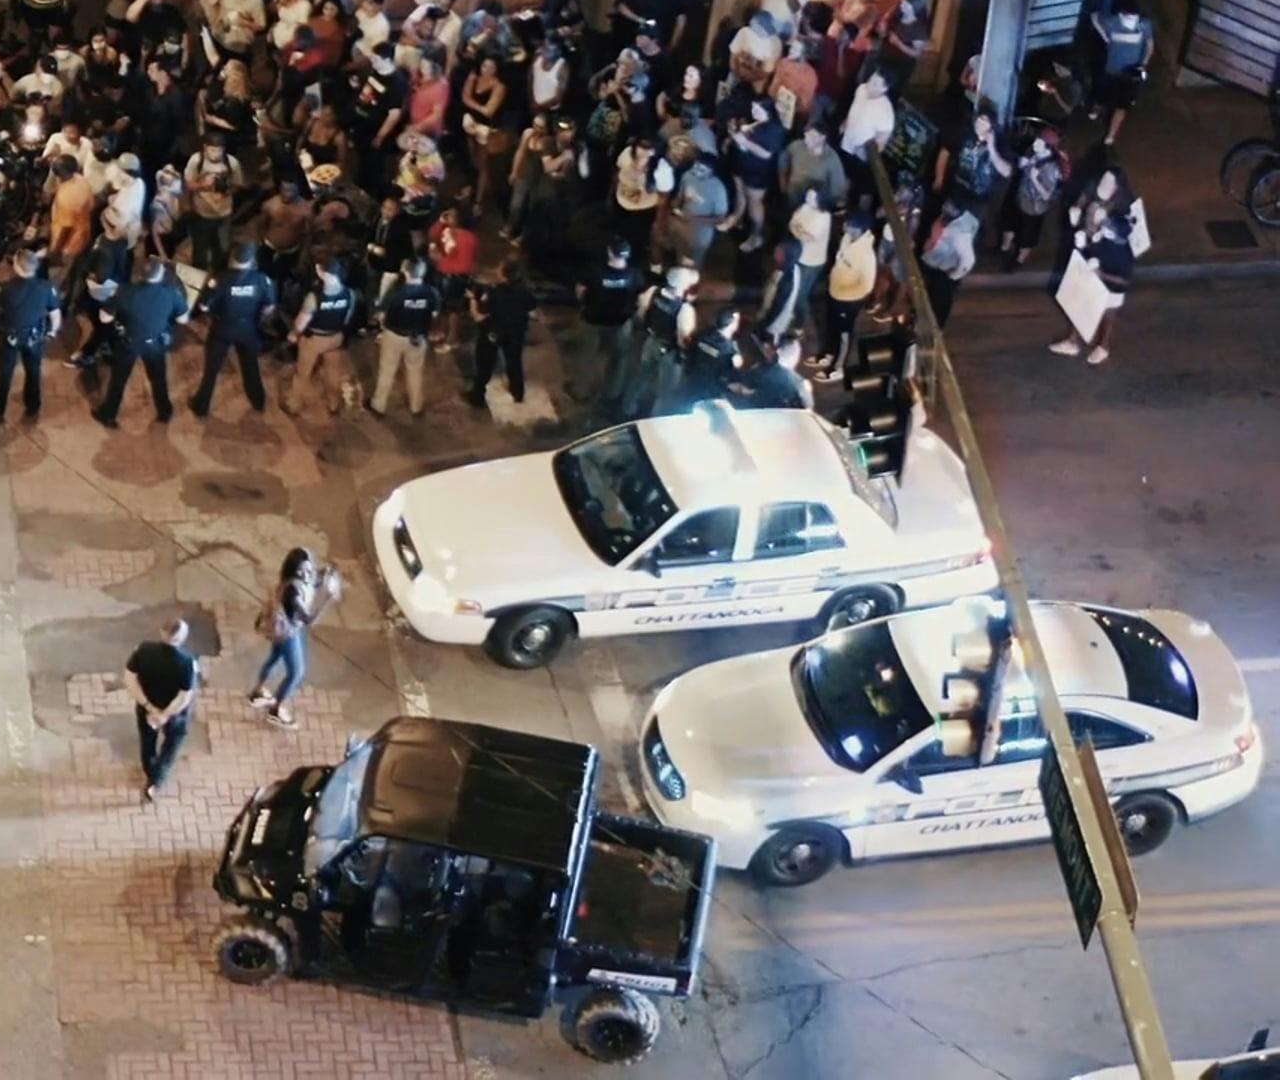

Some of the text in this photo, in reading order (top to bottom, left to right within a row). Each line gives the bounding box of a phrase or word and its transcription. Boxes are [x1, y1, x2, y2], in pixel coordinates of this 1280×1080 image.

[615, 575, 820, 610] POLICE
[633, 606, 784, 626] CHATTANOOGA
[919, 811, 1045, 835] CHATTANOO
